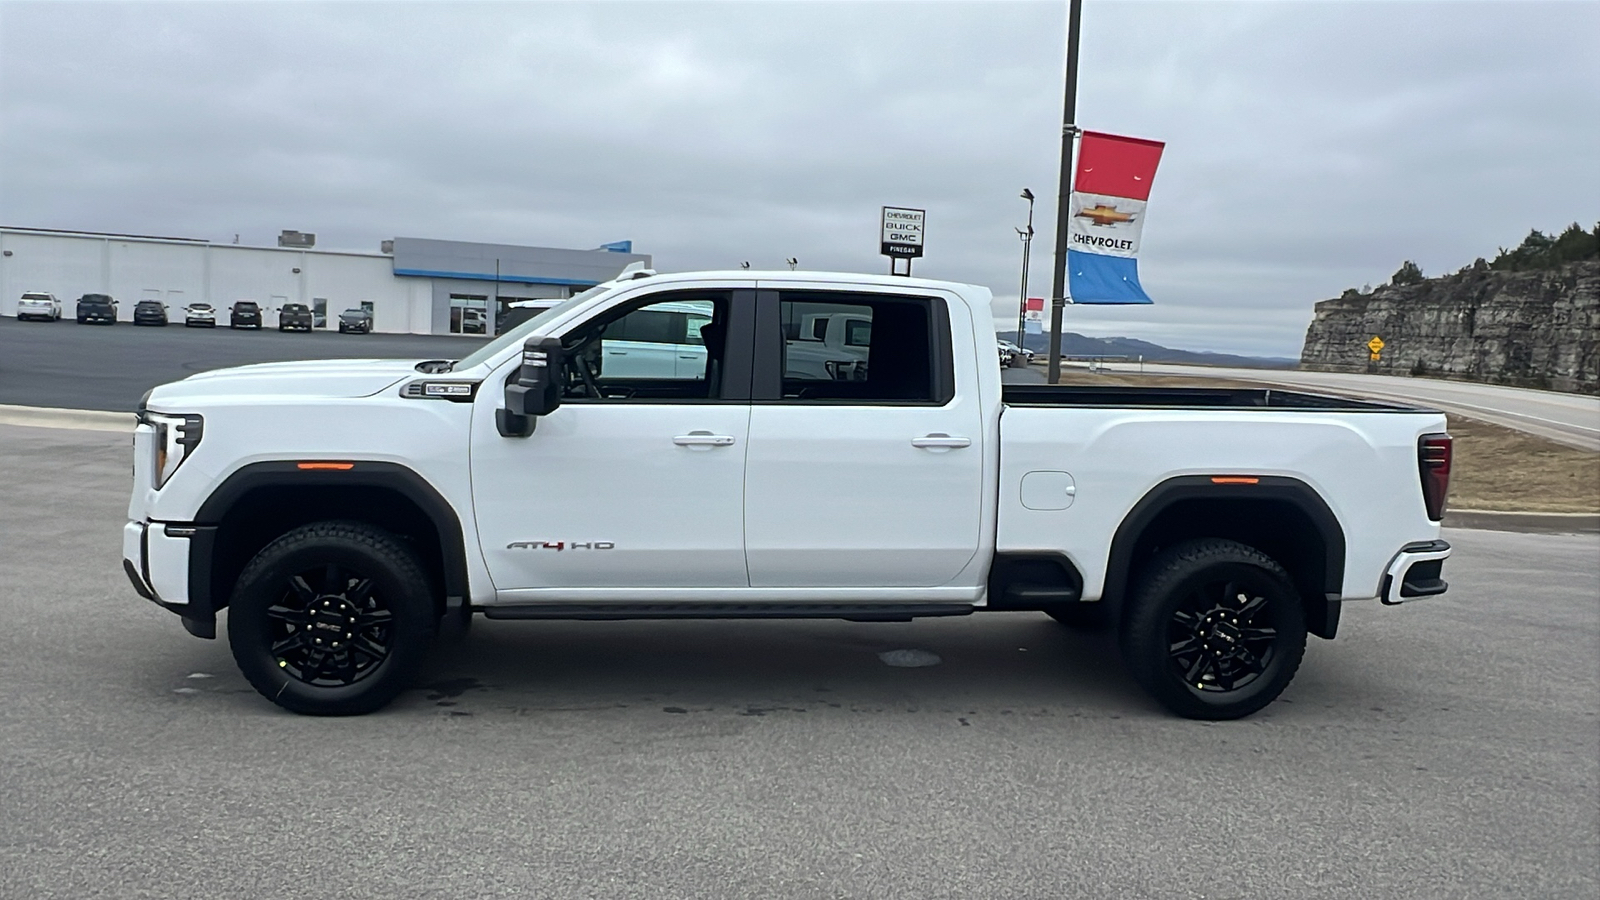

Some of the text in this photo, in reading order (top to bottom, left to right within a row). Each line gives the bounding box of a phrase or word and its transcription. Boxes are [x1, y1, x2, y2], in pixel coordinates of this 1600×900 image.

[887, 212, 921, 221] CHEVROLET
[886, 222, 921, 231] BUICK
[890, 233, 917, 242] GMC
[1073, 233, 1133, 251] CHEVROLET
[506, 541, 615, 552] AT4 HD
